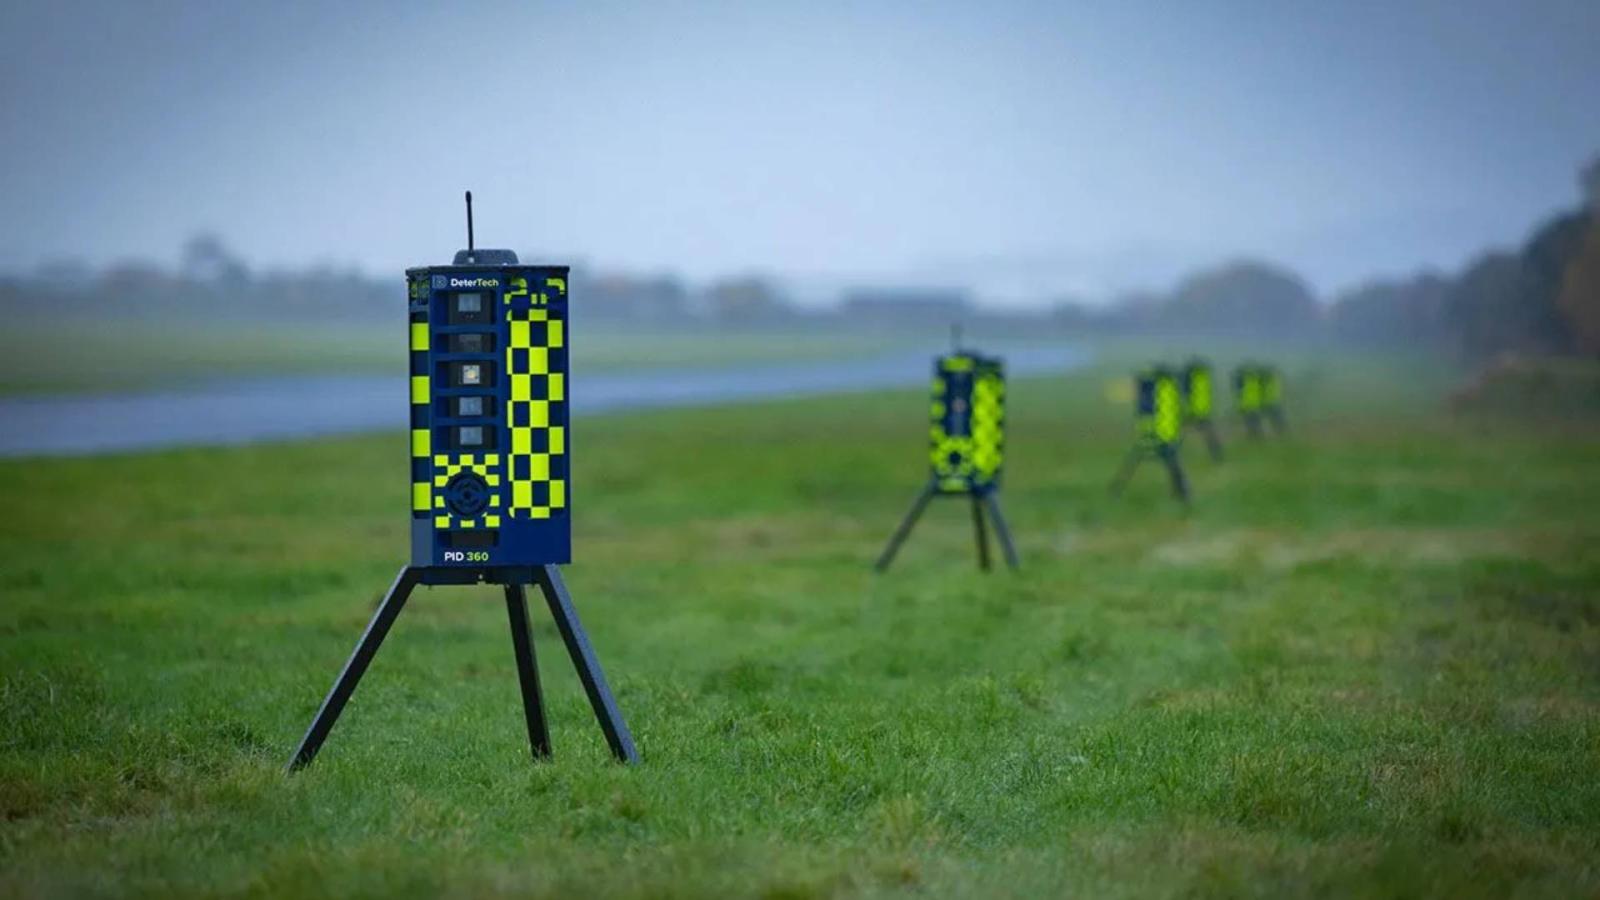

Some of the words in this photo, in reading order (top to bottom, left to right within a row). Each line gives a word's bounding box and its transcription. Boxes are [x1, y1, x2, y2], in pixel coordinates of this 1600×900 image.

[450, 278, 499, 287] DeterTech
[444, 551, 465, 561] PID
[466, 551, 489, 561] 360
